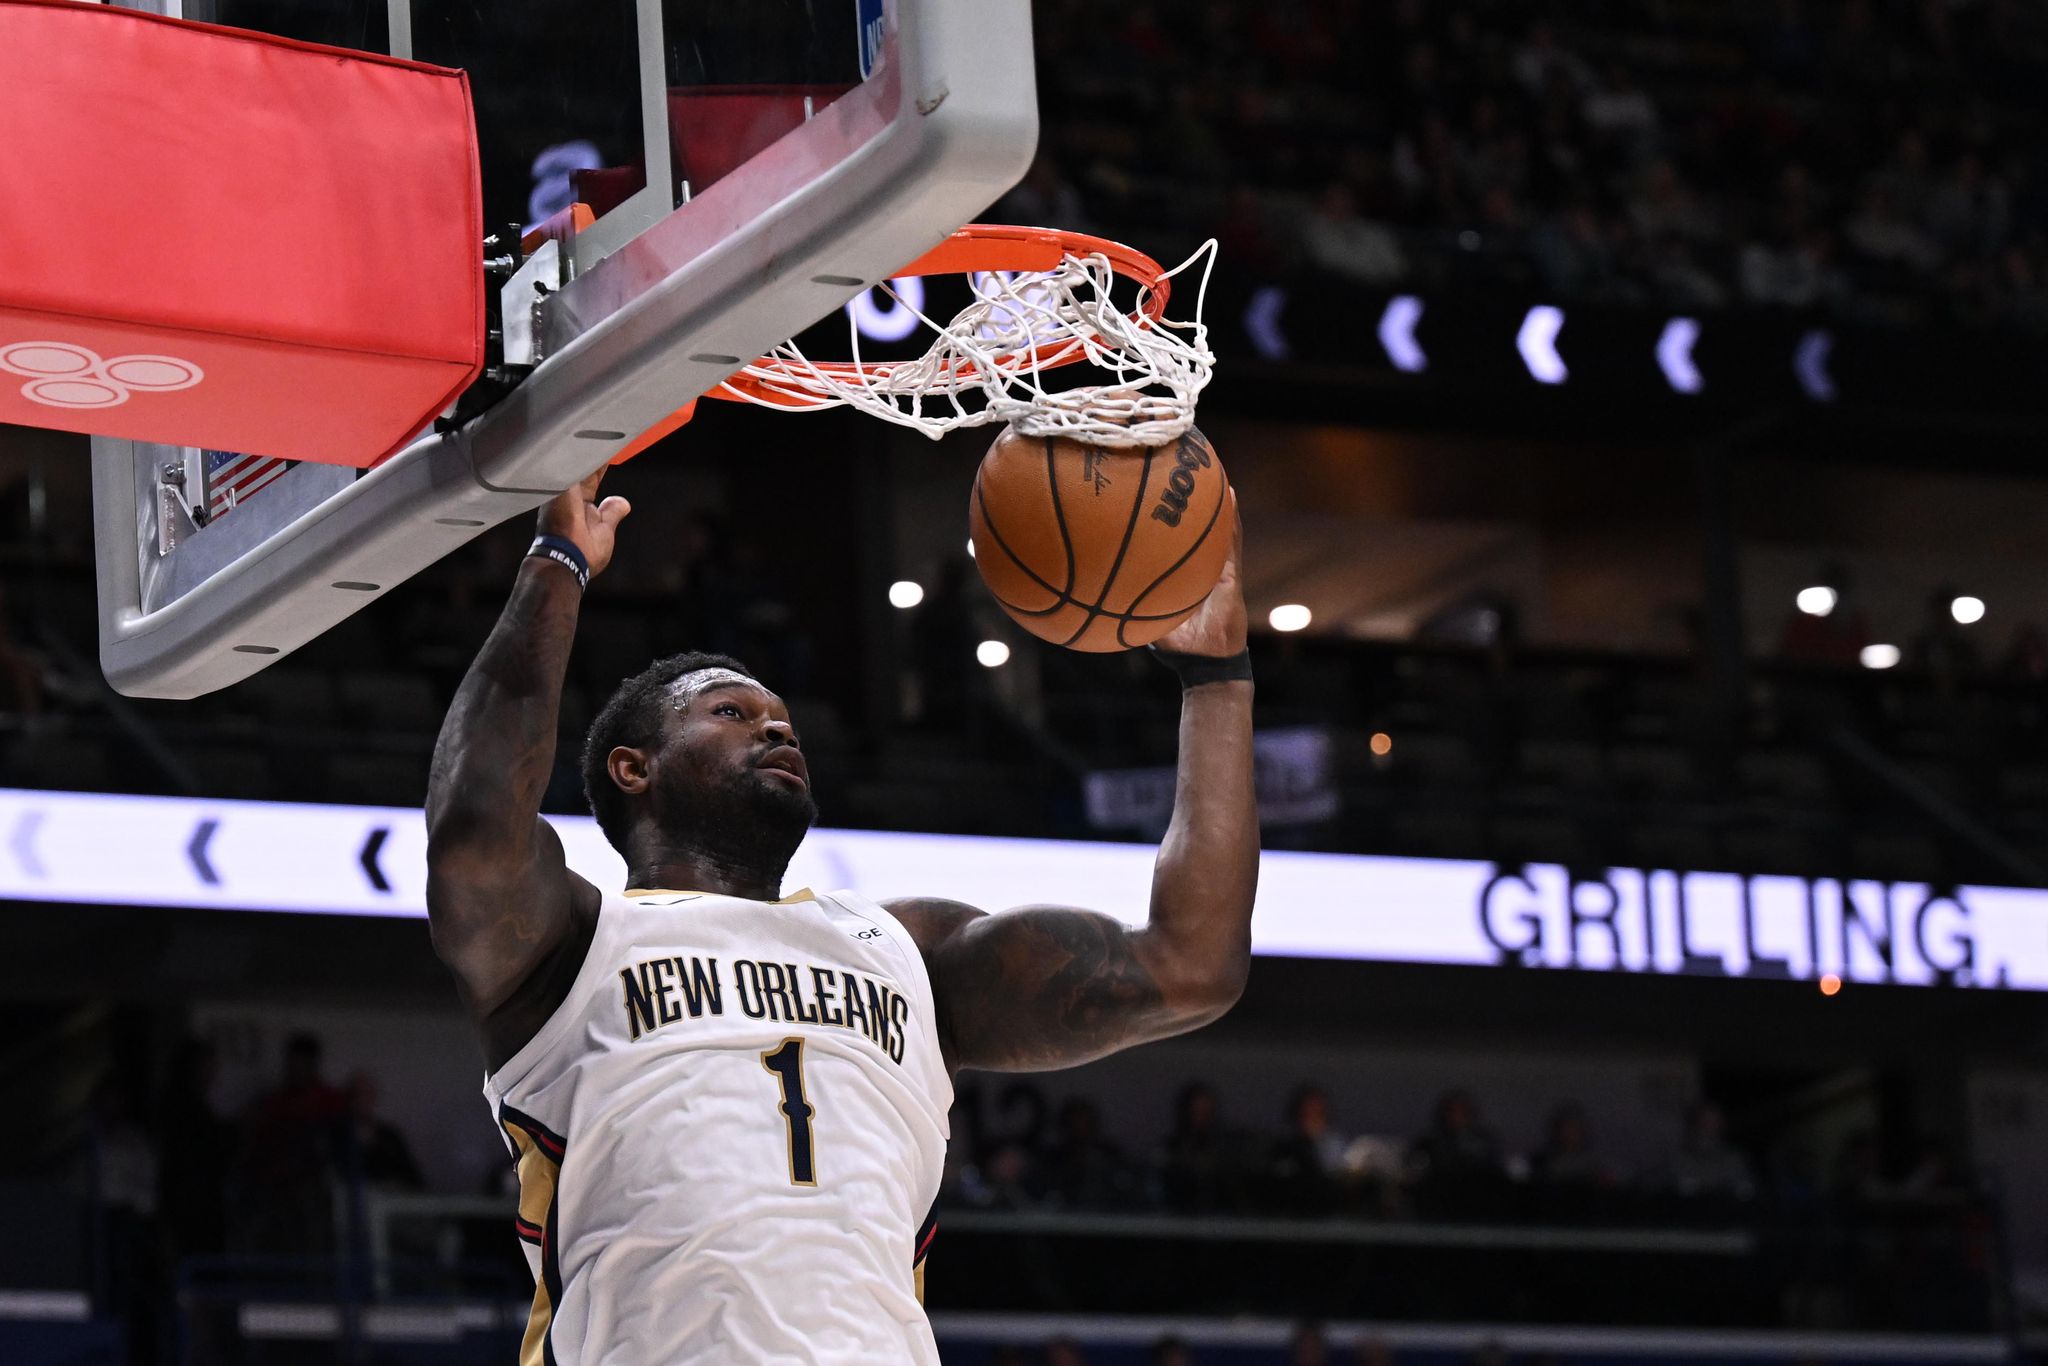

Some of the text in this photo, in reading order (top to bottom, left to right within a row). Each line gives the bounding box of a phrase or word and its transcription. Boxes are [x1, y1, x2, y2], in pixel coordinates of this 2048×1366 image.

[1152, 425, 1212, 528] lson
[549, 549, 580, 575] READY
[850, 928, 882, 940] GE
[619, 956, 909, 1066] NEW ORLEANS
[761, 1036, 818, 1187] 1
